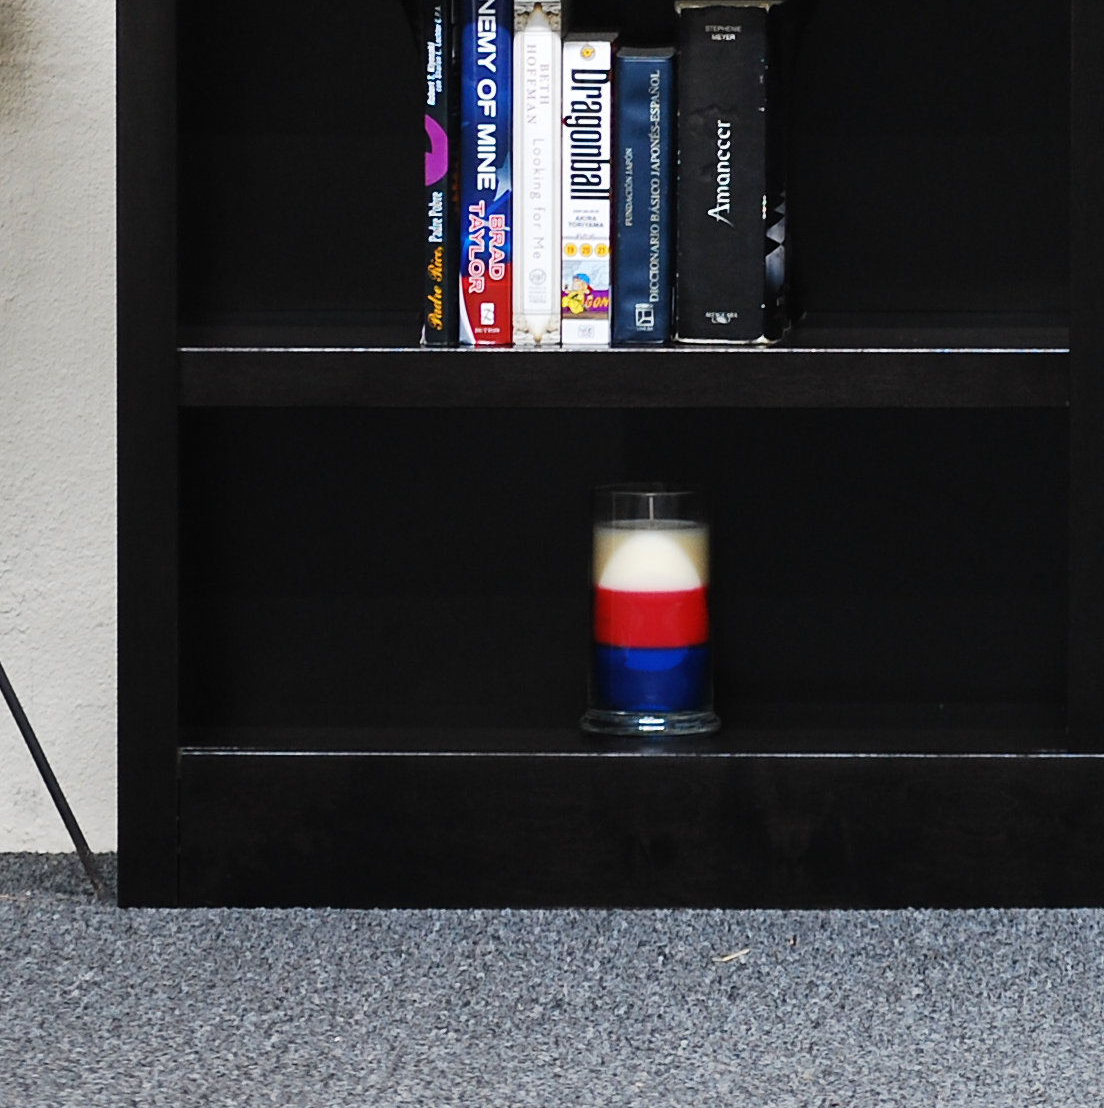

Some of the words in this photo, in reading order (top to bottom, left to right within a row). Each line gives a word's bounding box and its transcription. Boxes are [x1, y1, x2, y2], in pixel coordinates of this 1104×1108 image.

[476, 78, 497, 118] OF
[526, 44, 537, 125] HOFFMAN
[540, 64, 549, 105] BETH
[562, 68, 611, 200] Dragonball
[648, 69, 660, 176] JAPONÉS-ESPAÑOL
[477, 123, 497, 191] MINE
[529, 137, 545, 200] Looking
[624, 147, 633, 175] JAPÓN
[706, 119, 734, 228] Amanecer
[532, 207, 546, 228] for
[624, 175, 633, 227] FUNDACIÓN
[648, 178, 660, 222] BÁSICO
[428, 218, 443, 243] Padre
[468, 199, 486, 294] TAYLOR
[488, 213, 506, 281] BRAD
[532, 237, 545, 259] Me
[649, 224, 660, 303] DICCIONARIO
[427, 285, 443, 330] Padre
